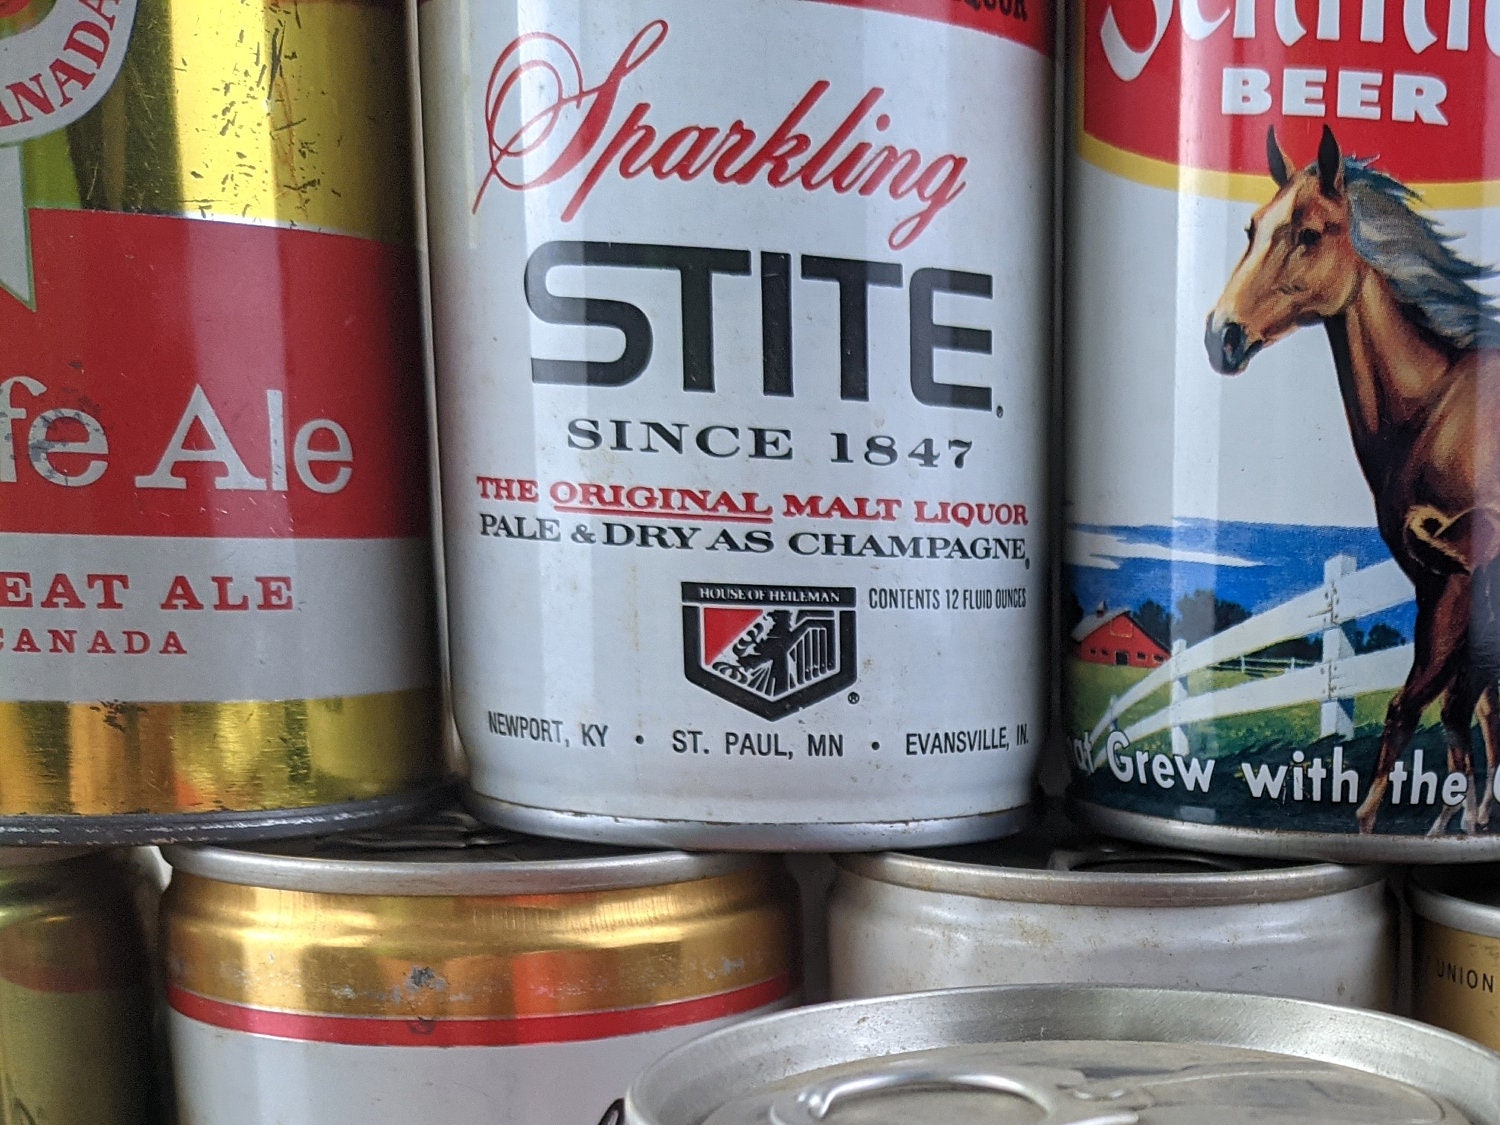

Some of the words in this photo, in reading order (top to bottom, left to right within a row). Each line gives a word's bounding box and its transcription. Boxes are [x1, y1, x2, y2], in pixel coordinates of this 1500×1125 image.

[1221, 67, 1449, 125] BEER
[473, 20, 967, 250] Sparkling
[134, 385, 353, 494] Ale
[567, 419, 793, 462] SINCE
[831, 432, 973, 469] 1847
[476, 476, 539, 503] THE
[550, 481, 774, 524] ORIGINAL
[783, 495, 903, 522] MALT
[914, 501, 1029, 527] LIQUOR
[480, 513, 562, 542] PALE
[571, 524, 597, 544] &
[602, 522, 702, 550] DRY
[705, 529, 775, 553] AS
[160, 575, 295, 612] ALE
[699, 587, 747, 601] HOUSE
[748, 589, 766, 601] OF
[769, 590, 841, 603] HEILEMAN
[868, 588, 941, 610] CONTENTS
[945, 589, 960, 610] 12
[963, 590, 992, 610] FLUID
[995, 587, 1027, 609] OUNCES
[0, 627, 188, 656] ANADA
[488, 711, 570, 748] NEWPORT,
[581, 723, 609, 748] KY
[672, 730, 709, 755] ST.
[726, 732, 794, 760] PAUL,
[808, 735, 844, 757] MN
[906, 727, 1010, 756] EVANSVILLE,
[1017, 723, 1030, 746] IN.
[1106, 730, 1215, 793] Grew
[1243, 747, 1359, 805] with
[1389, 749, 1467, 806] the
[1437, 958, 1495, 994] UNION
